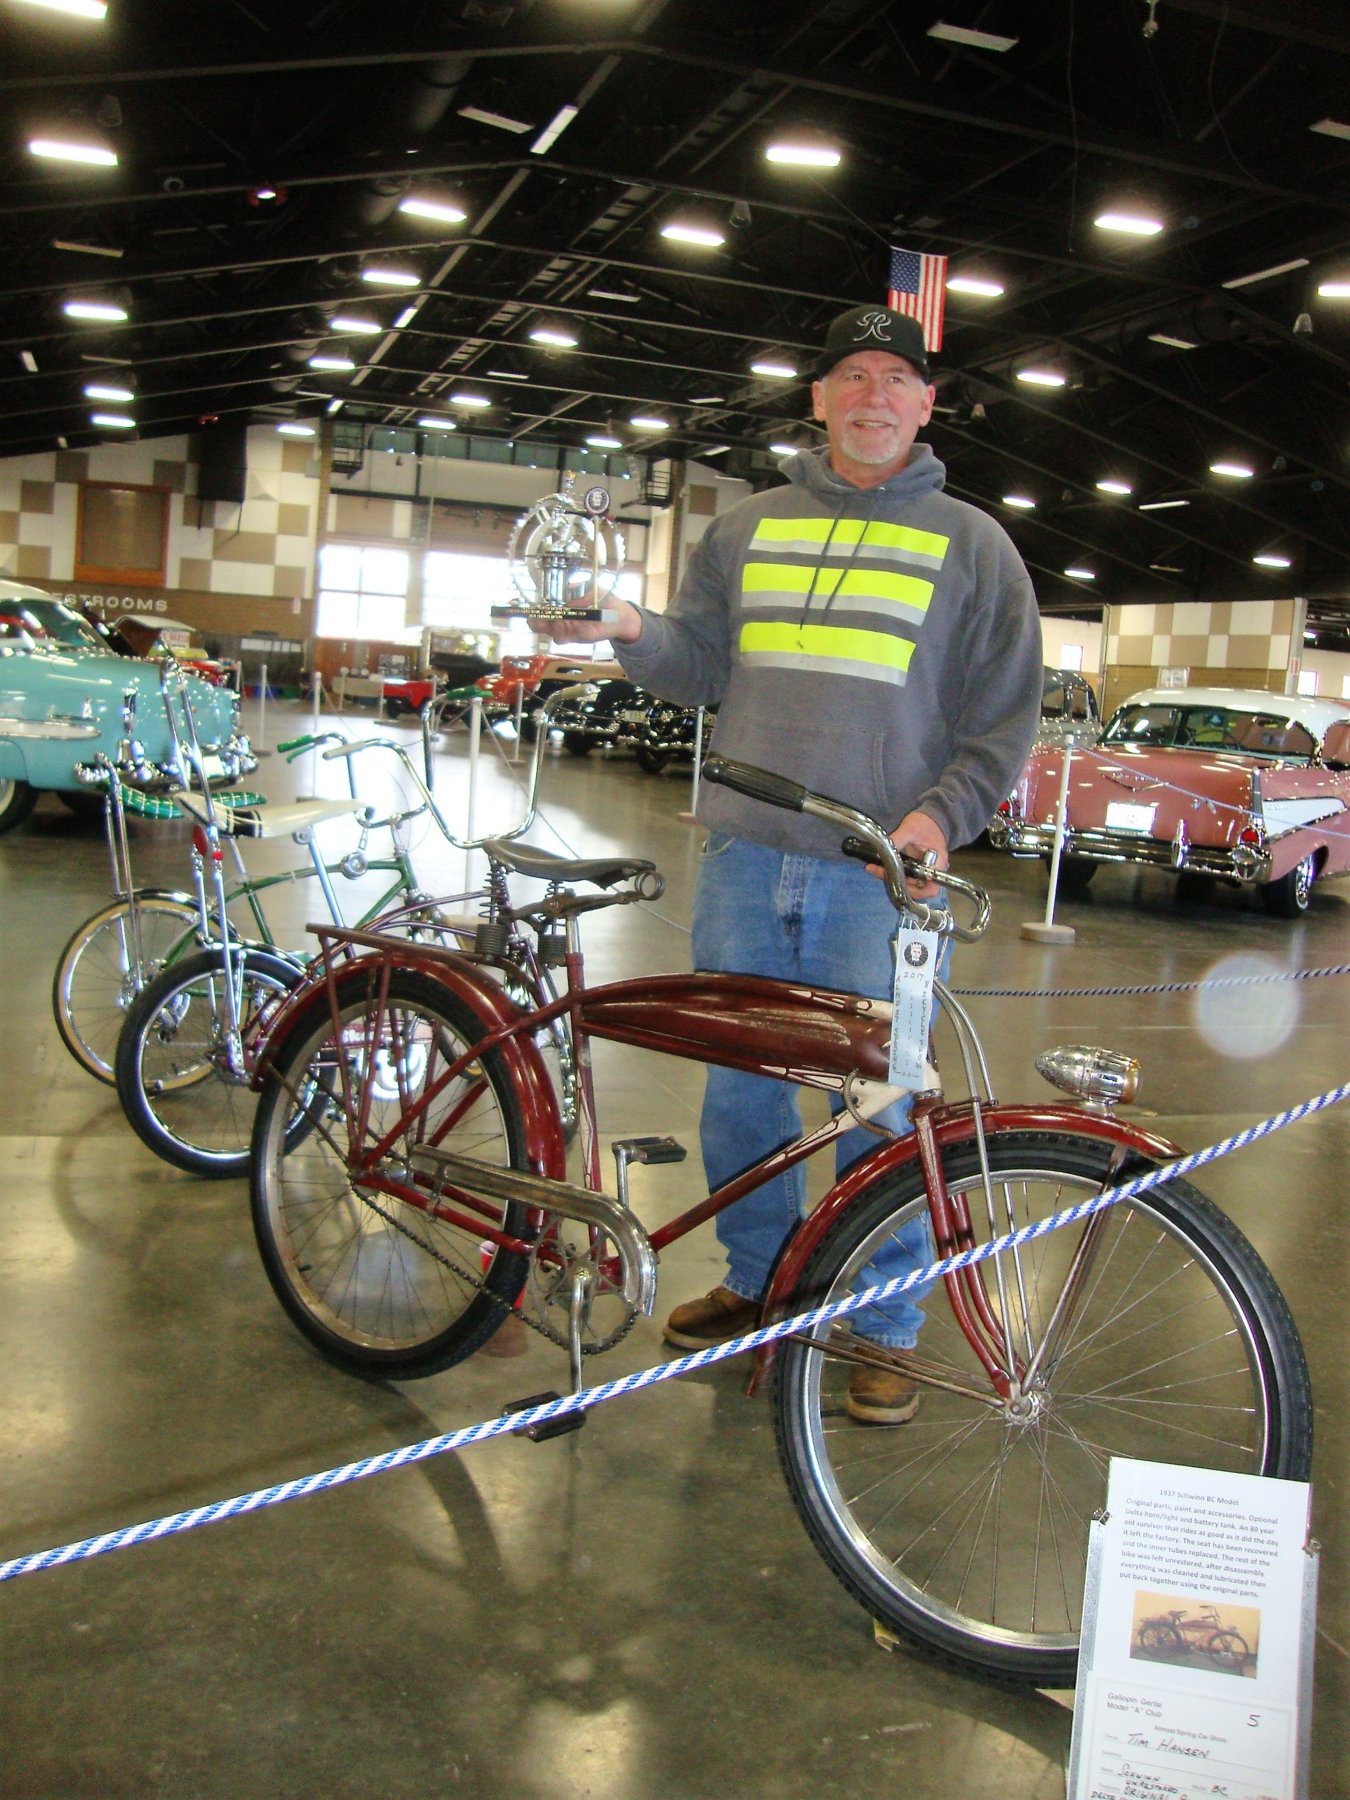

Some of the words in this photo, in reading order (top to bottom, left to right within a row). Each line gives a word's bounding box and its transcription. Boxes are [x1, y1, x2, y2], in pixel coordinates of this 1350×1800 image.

[903, 971, 925, 982] 2017
[1159, 1489, 1175, 1497] 1937
[1177, 1491, 1205, 1501] Schwinn
[1216, 1497, 1239, 1505] Model
[1125, 1508, 1143, 1516] Delta
[1144, 1511, 1178, 1522] horn/light
[1194, 1518, 1218, 1528] battery
[1220, 1521, 1236, 1529] tank.
[1260, 1528, 1275, 1536] year
[1126, 1497, 1152, 1508] Original
[1174, 1505, 1191, 1514] paint
[1248, 1515, 1278, 1526] Optional
[1136, 1521, 1163, 1530] survivor
[1164, 1524, 1179, 1532] that
[1180, 1526, 1197, 1535] rides
[1207, 1530, 1224, 1540] good
[1241, 1535, 1252, 1543] did
[1266, 1539, 1278, 1547] day
[1155, 1533, 1181, 1544] factory.
[1225, 1544, 1243, 1552] been
[1244, 1547, 1278, 1557] recovered
[1121, 1550, 1136, 1558] bike
[1151, 1554, 1163, 1562] left
[1205, 1562, 1222, 1570] after
[1223, 1565, 1264, 1577] disassembly
[1136, 1541, 1147, 1549] the
[1168, 1546, 1187, 1555] tubes
[1188, 1549, 1220, 1560] replaced.
[1235, 1556, 1248, 1564] rest
[1258, 1559, 1270, 1567] the
[1119, 1571, 1131, 1579] put
[1132, 1573, 1148, 1581] back
[1149, 1575, 1179, 1586] together
[1180, 1580, 1198, 1590] using
[1212, 1585, 1238, 1595] original
[1239, 1589, 1259, 1598] parts.
[1120, 1561, 1156, 1572] everything
[1172, 1568, 1198, 1578] cleaned
[1200, 1572, 1212, 1580] and
[1214, 1574, 1248, 1585] lubricated
[1250, 1580, 1266, 1588] then
[1107, 1701, 1128, 1712] Model
[1145, 1708, 1162, 1717] Club
[1157, 1738, 1209, 1758] HANSEN
[1211, 1784, 1228, 1796] BC
